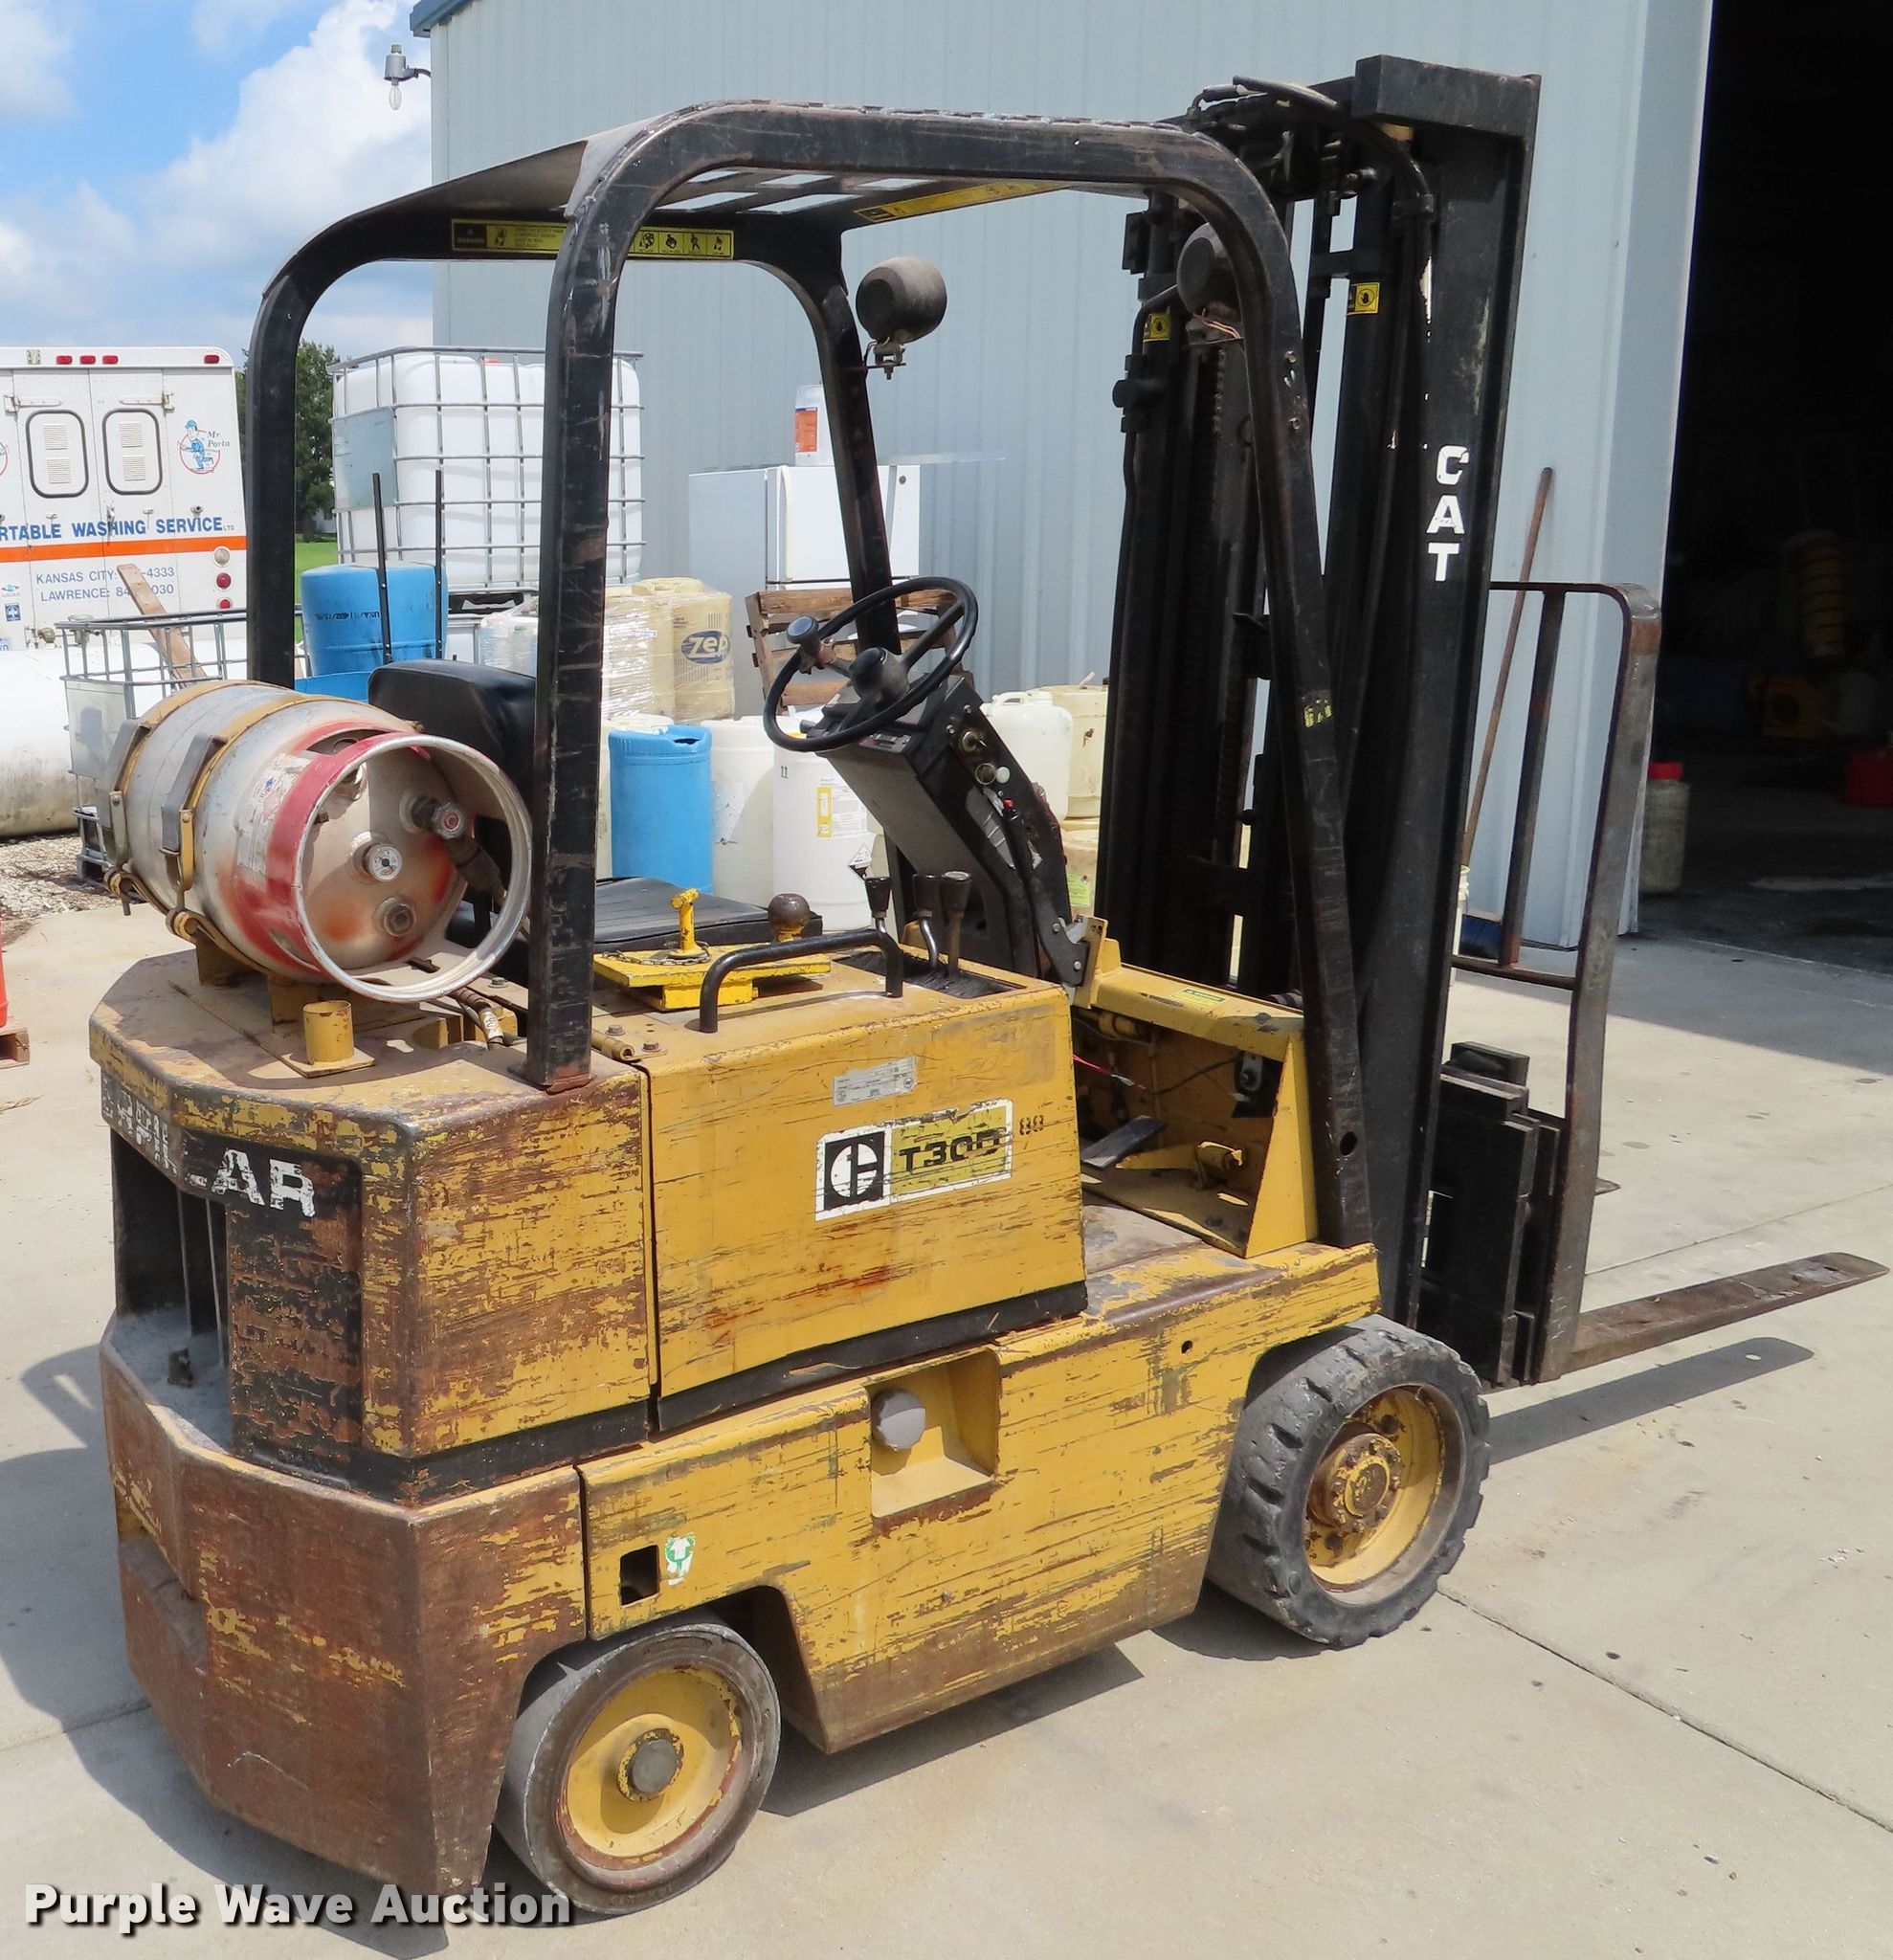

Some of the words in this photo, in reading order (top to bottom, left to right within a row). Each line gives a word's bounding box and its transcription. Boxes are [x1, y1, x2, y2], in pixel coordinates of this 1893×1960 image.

[1426, 445, 1470, 582] CAT
[72, 520, 145, 538] WASHING
[156, 517, 223, 533] SERVICE
[36, 571, 83, 584] KANSAS
[89, 570, 117, 582] CITY:
[40, 588, 110, 602] LAWRENCE:
